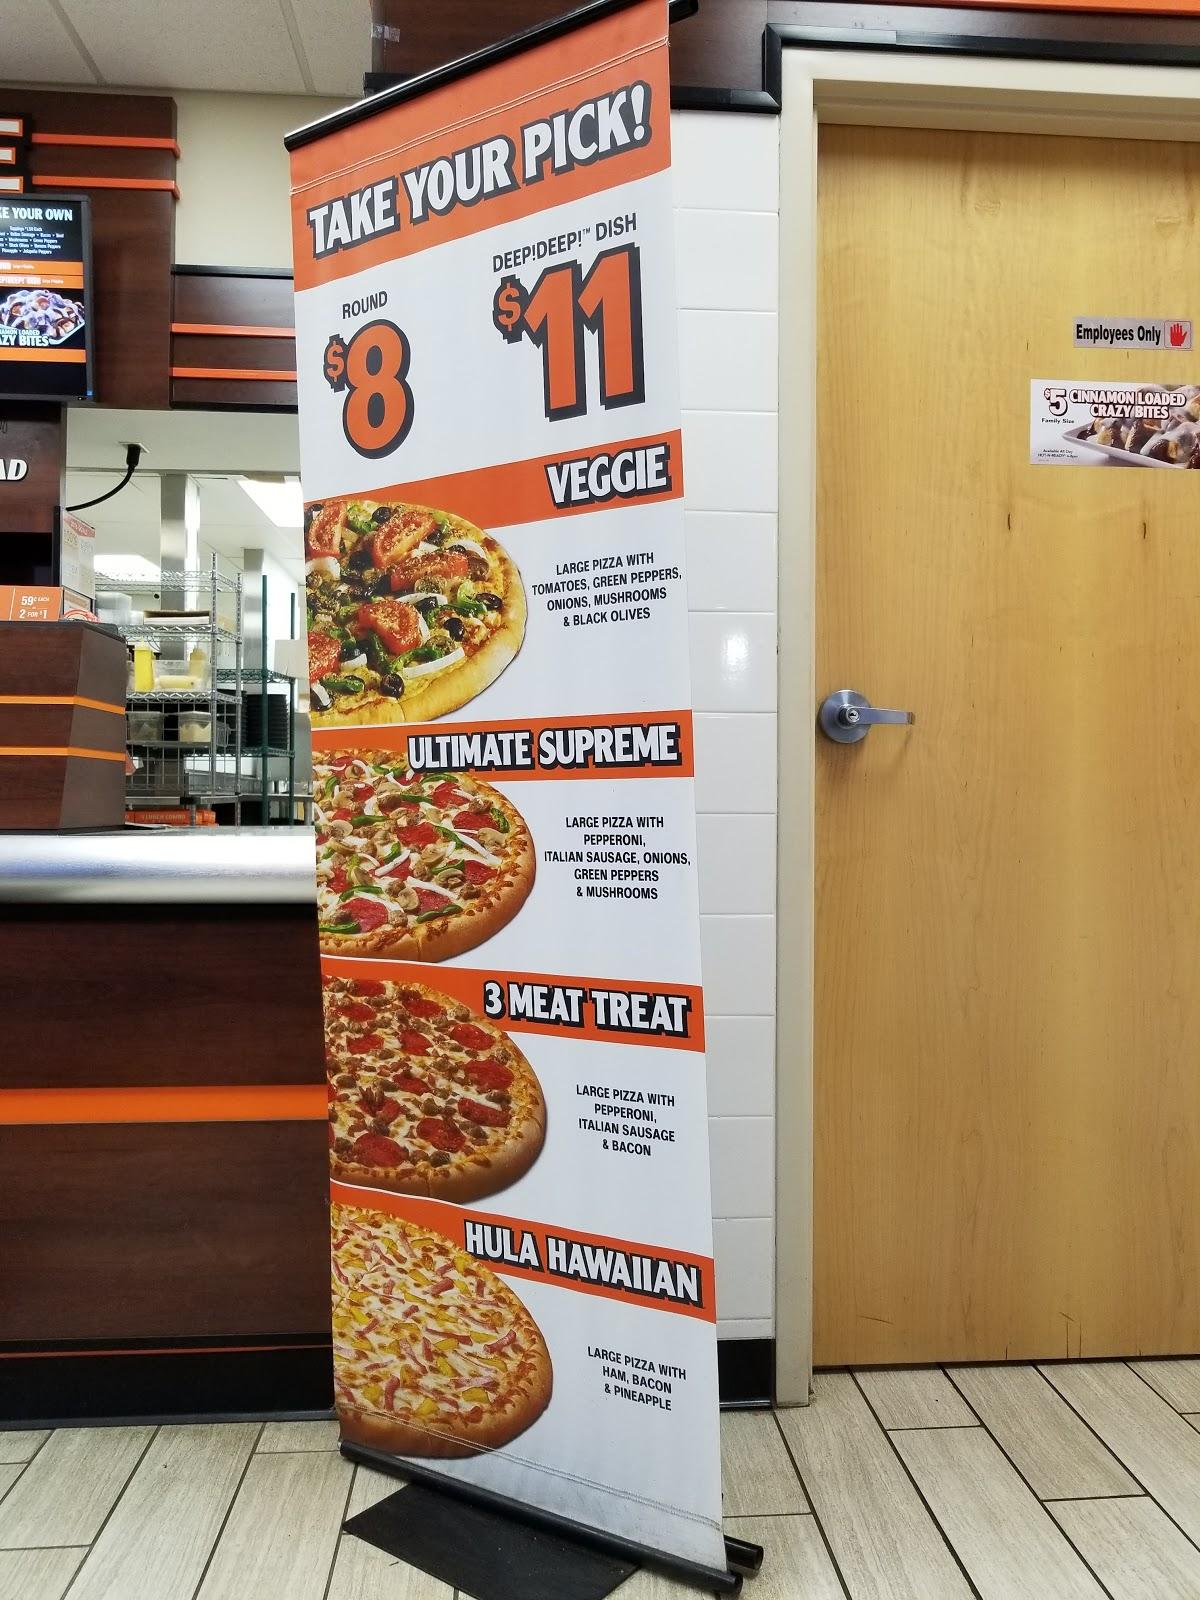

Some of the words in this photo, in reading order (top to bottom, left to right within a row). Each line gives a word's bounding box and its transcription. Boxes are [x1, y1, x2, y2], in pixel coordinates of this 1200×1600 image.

[307, 178, 398, 258] TAKE
[403, 136, 515, 223] YOUR
[522, 81, 649, 184] PICK!
[12, 207, 43, 220] YOUR
[45, 208, 73, 221] OWN
[595, 212, 638, 243] DISH
[342, 290, 388, 319] ROUND
[19, 335, 49, 346] BITES
[492, 242, 645, 423] $11
[1076, 324, 1134, 345] Employees
[1137, 325, 1161, 345] Only
[323, 319, 414, 459] $8
[1044, 388, 1068, 416] $5
[1069, 389, 1135, 404] CINNAMON
[1137, 391, 1187, 407] LOADED
[1090, 404, 1131, 418] CRAZY
[1134, 405, 1170, 420] BITES
[545, 444, 671, 508] VEGGIE
[556, 560, 590, 576] LARGE
[592, 557, 624, 573] PIZZA
[626, 552, 655, 566] WITH
[531, 579, 590, 596] TOMATOES,
[592, 573, 627, 589] GREEN
[630, 566, 682, 583] PEPPERS,
[546, 594, 591, 612] ONIONS,
[594, 587, 667, 606] MUSHROOMS
[19, 609, 26, 619] 2
[563, 616, 571, 627] &
[573, 612, 608, 627] BLACK
[610, 607, 650, 624] OLIVES
[408, 731, 534, 771] ULTIMATE
[538, 723, 681, 768] SUPREME
[565, 817, 600, 828] LARGE
[602, 817, 633, 828] PIZZA
[636, 816, 664, 828] WITH
[583, 834, 646, 848] PEPPERONI,
[544, 850, 584, 863] ITALIAN
[586, 851, 640, 865] SAUSAGE,
[643, 852, 691, 867] ONIONS,
[574, 869, 608, 881] GREEN
[611, 870, 659, 882] PEPPERS
[576, 887, 583, 897] &
[586, 886, 658, 900] MUSHROOMS
[484, 981, 505, 1019] 3
[508, 981, 585, 1028] MEAT
[590, 989, 691, 1038] TREAT
[576, 1084, 610, 1099] LARGE
[613, 1088, 644, 1103] PIZZA
[647, 1092, 675, 1107] WITH
[594, 1103, 657, 1124] PEPPERONI,
[578, 1118, 619, 1135] ITALIAN
[622, 1124, 676, 1143] SAUSAGE
[602, 1139, 609, 1150] &
[612, 1142, 652, 1156] BACON
[464, 1220, 543, 1271] HULA
[547, 1235, 703, 1308] HAWAIIAN
[587, 1346, 622, 1364] LARGE
[624, 1355, 656, 1373] PIZZA
[658, 1362, 687, 1380] WITH
[602, 1366, 630, 1384] HAM,
[632, 1374, 672, 1394] BACON
[604, 1383, 611, 1394] &
[614, 1385, 672, 1411] PINEAPPLE
